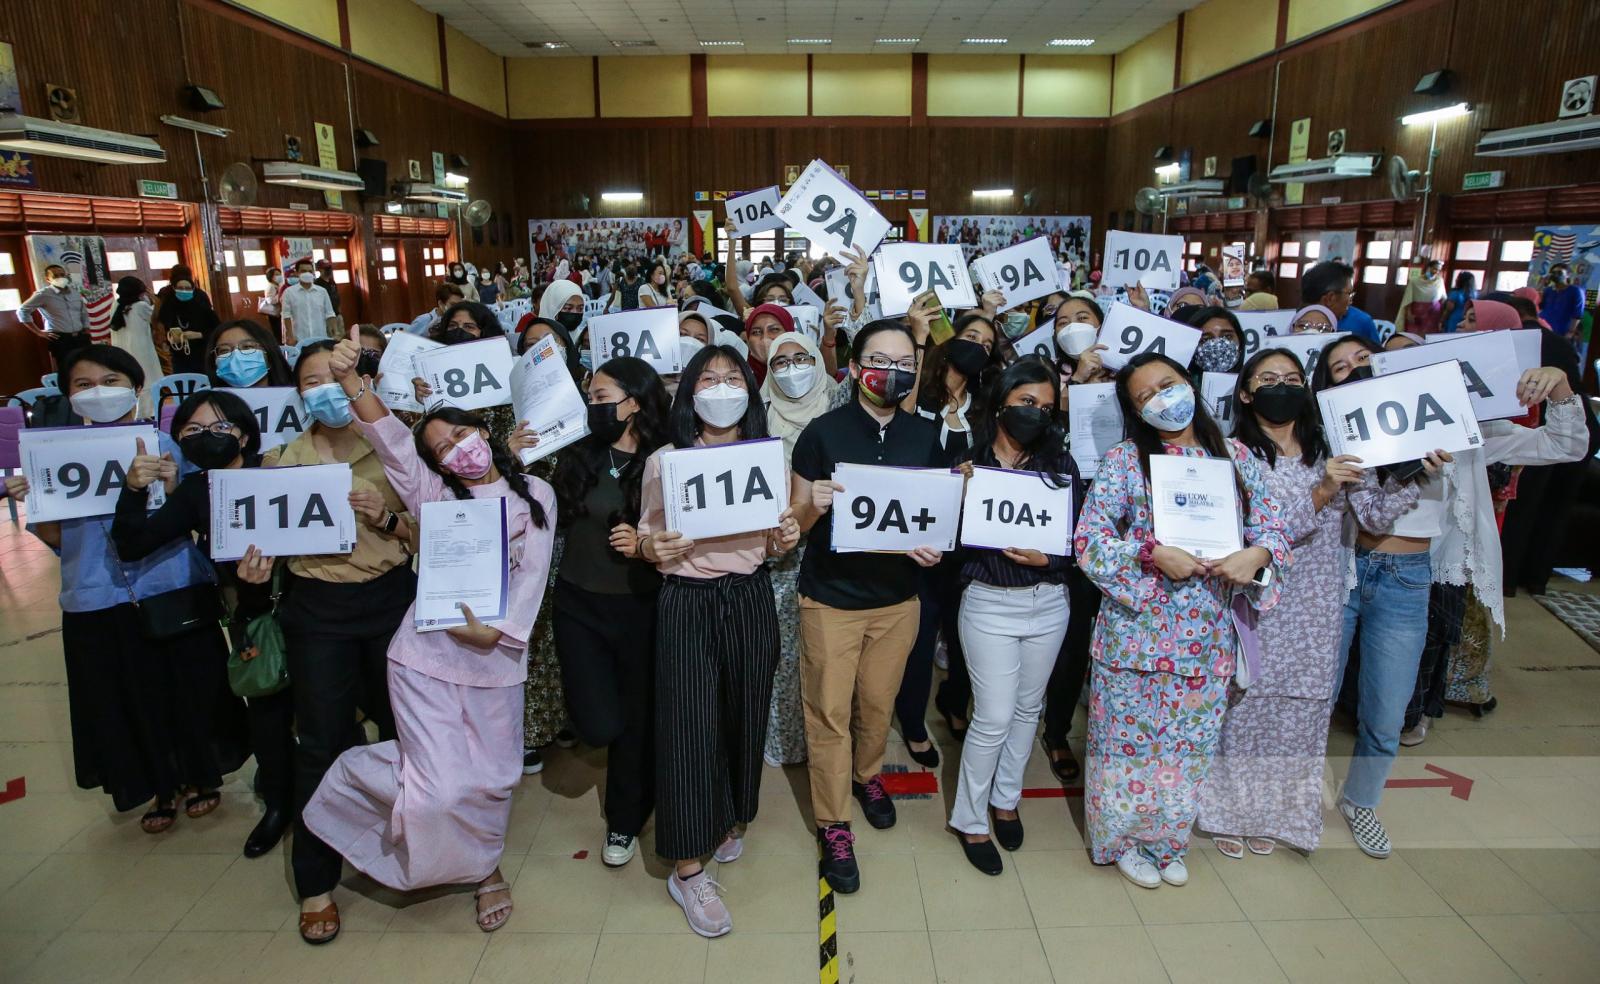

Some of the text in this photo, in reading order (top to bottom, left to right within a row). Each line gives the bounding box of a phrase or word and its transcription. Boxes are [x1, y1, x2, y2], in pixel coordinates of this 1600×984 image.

[734, 200, 774, 224] 10A
[807, 194, 857, 249] 9A
[899, 261, 954, 294] 9A
[1000, 258, 1045, 291] 9A
[1118, 248, 1172, 272] 10A
[610, 329, 662, 360] 8A
[443, 363, 503, 398] 8A
[1345, 392, 1455, 442] 10A
[57, 459, 127, 500] 9A
[686, 465, 774, 510] 11A
[237, 492, 335, 530] 11A
[851, 495, 937, 534] 9A+
[982, 498, 1052, 528] 10A+
